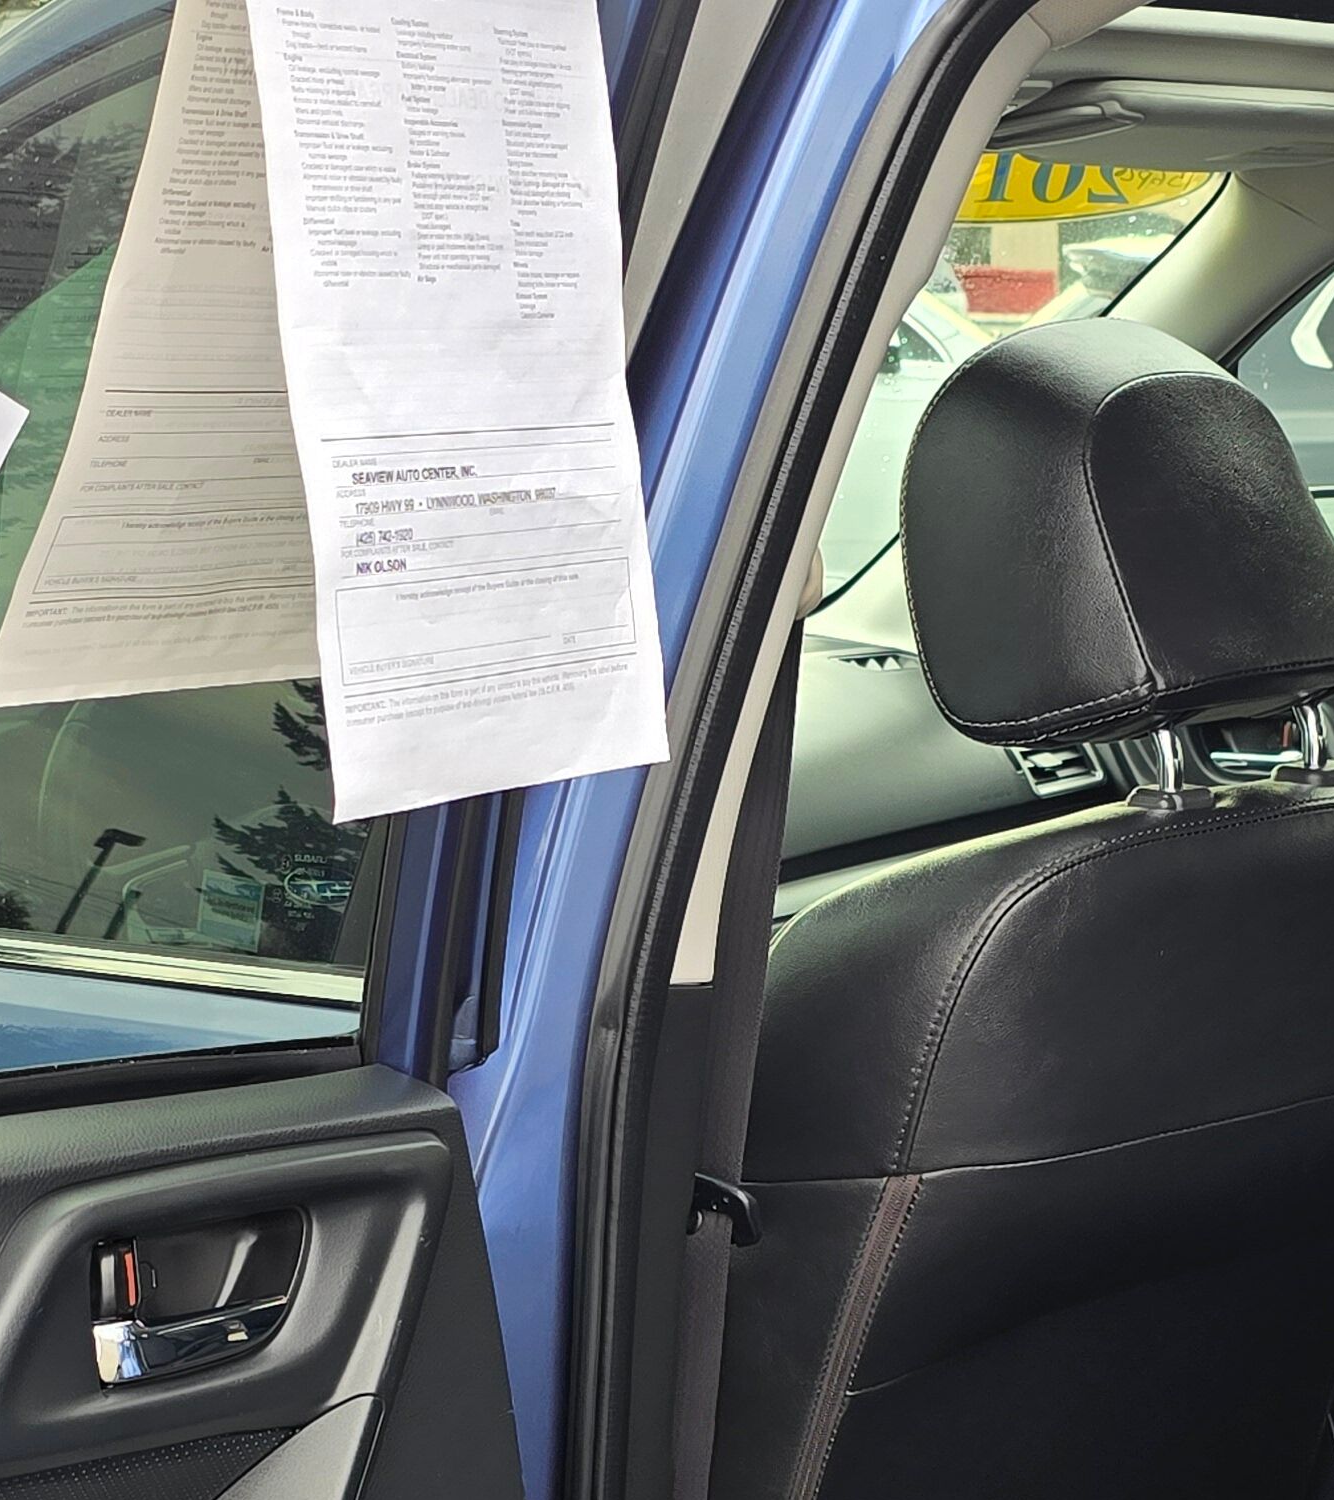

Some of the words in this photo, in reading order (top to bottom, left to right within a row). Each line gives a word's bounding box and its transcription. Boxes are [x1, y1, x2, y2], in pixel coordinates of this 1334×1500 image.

[352, 470, 394, 485] SEAVIEW
[396, 469, 420, 482] AUTO
[460, 465, 478, 477] INC.
[380, 499, 403, 513] HWY
[404, 498, 415, 511] 99
[477, 490, 531, 505] WASHINGTON
[356, 561, 373, 576] NIK
[373, 558, 407, 574] OLSON
